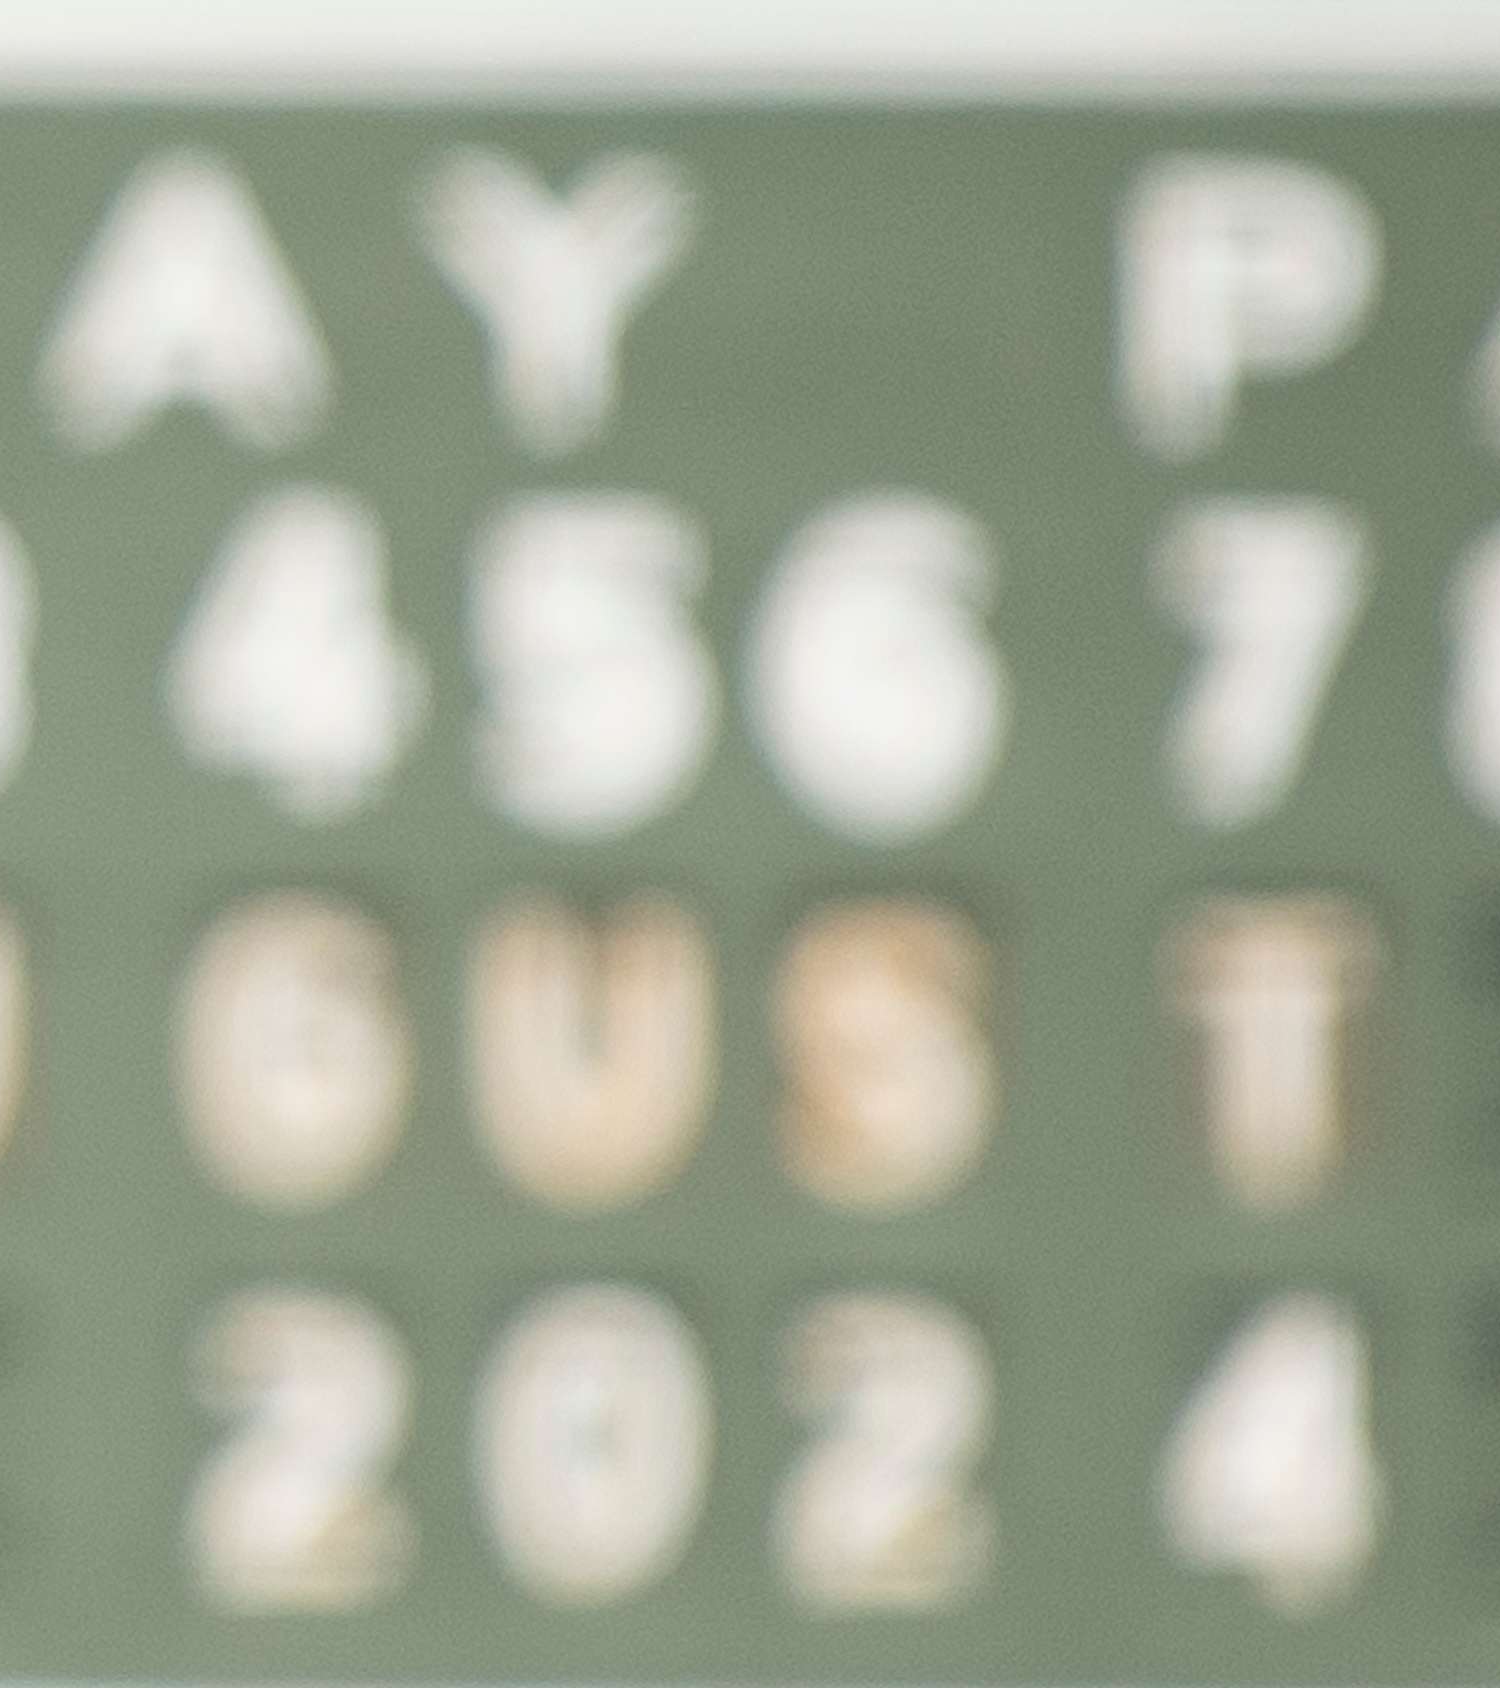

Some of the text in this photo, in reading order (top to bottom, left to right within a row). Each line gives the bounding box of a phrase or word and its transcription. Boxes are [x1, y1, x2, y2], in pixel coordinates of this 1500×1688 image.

[172, 488, 424, 818] 4
[472, 492, 717, 838] 5
[750, 494, 1006, 840] 6
[1160, 498, 1368, 826] 7
[185, 1282, 1384, 1616] 2024
